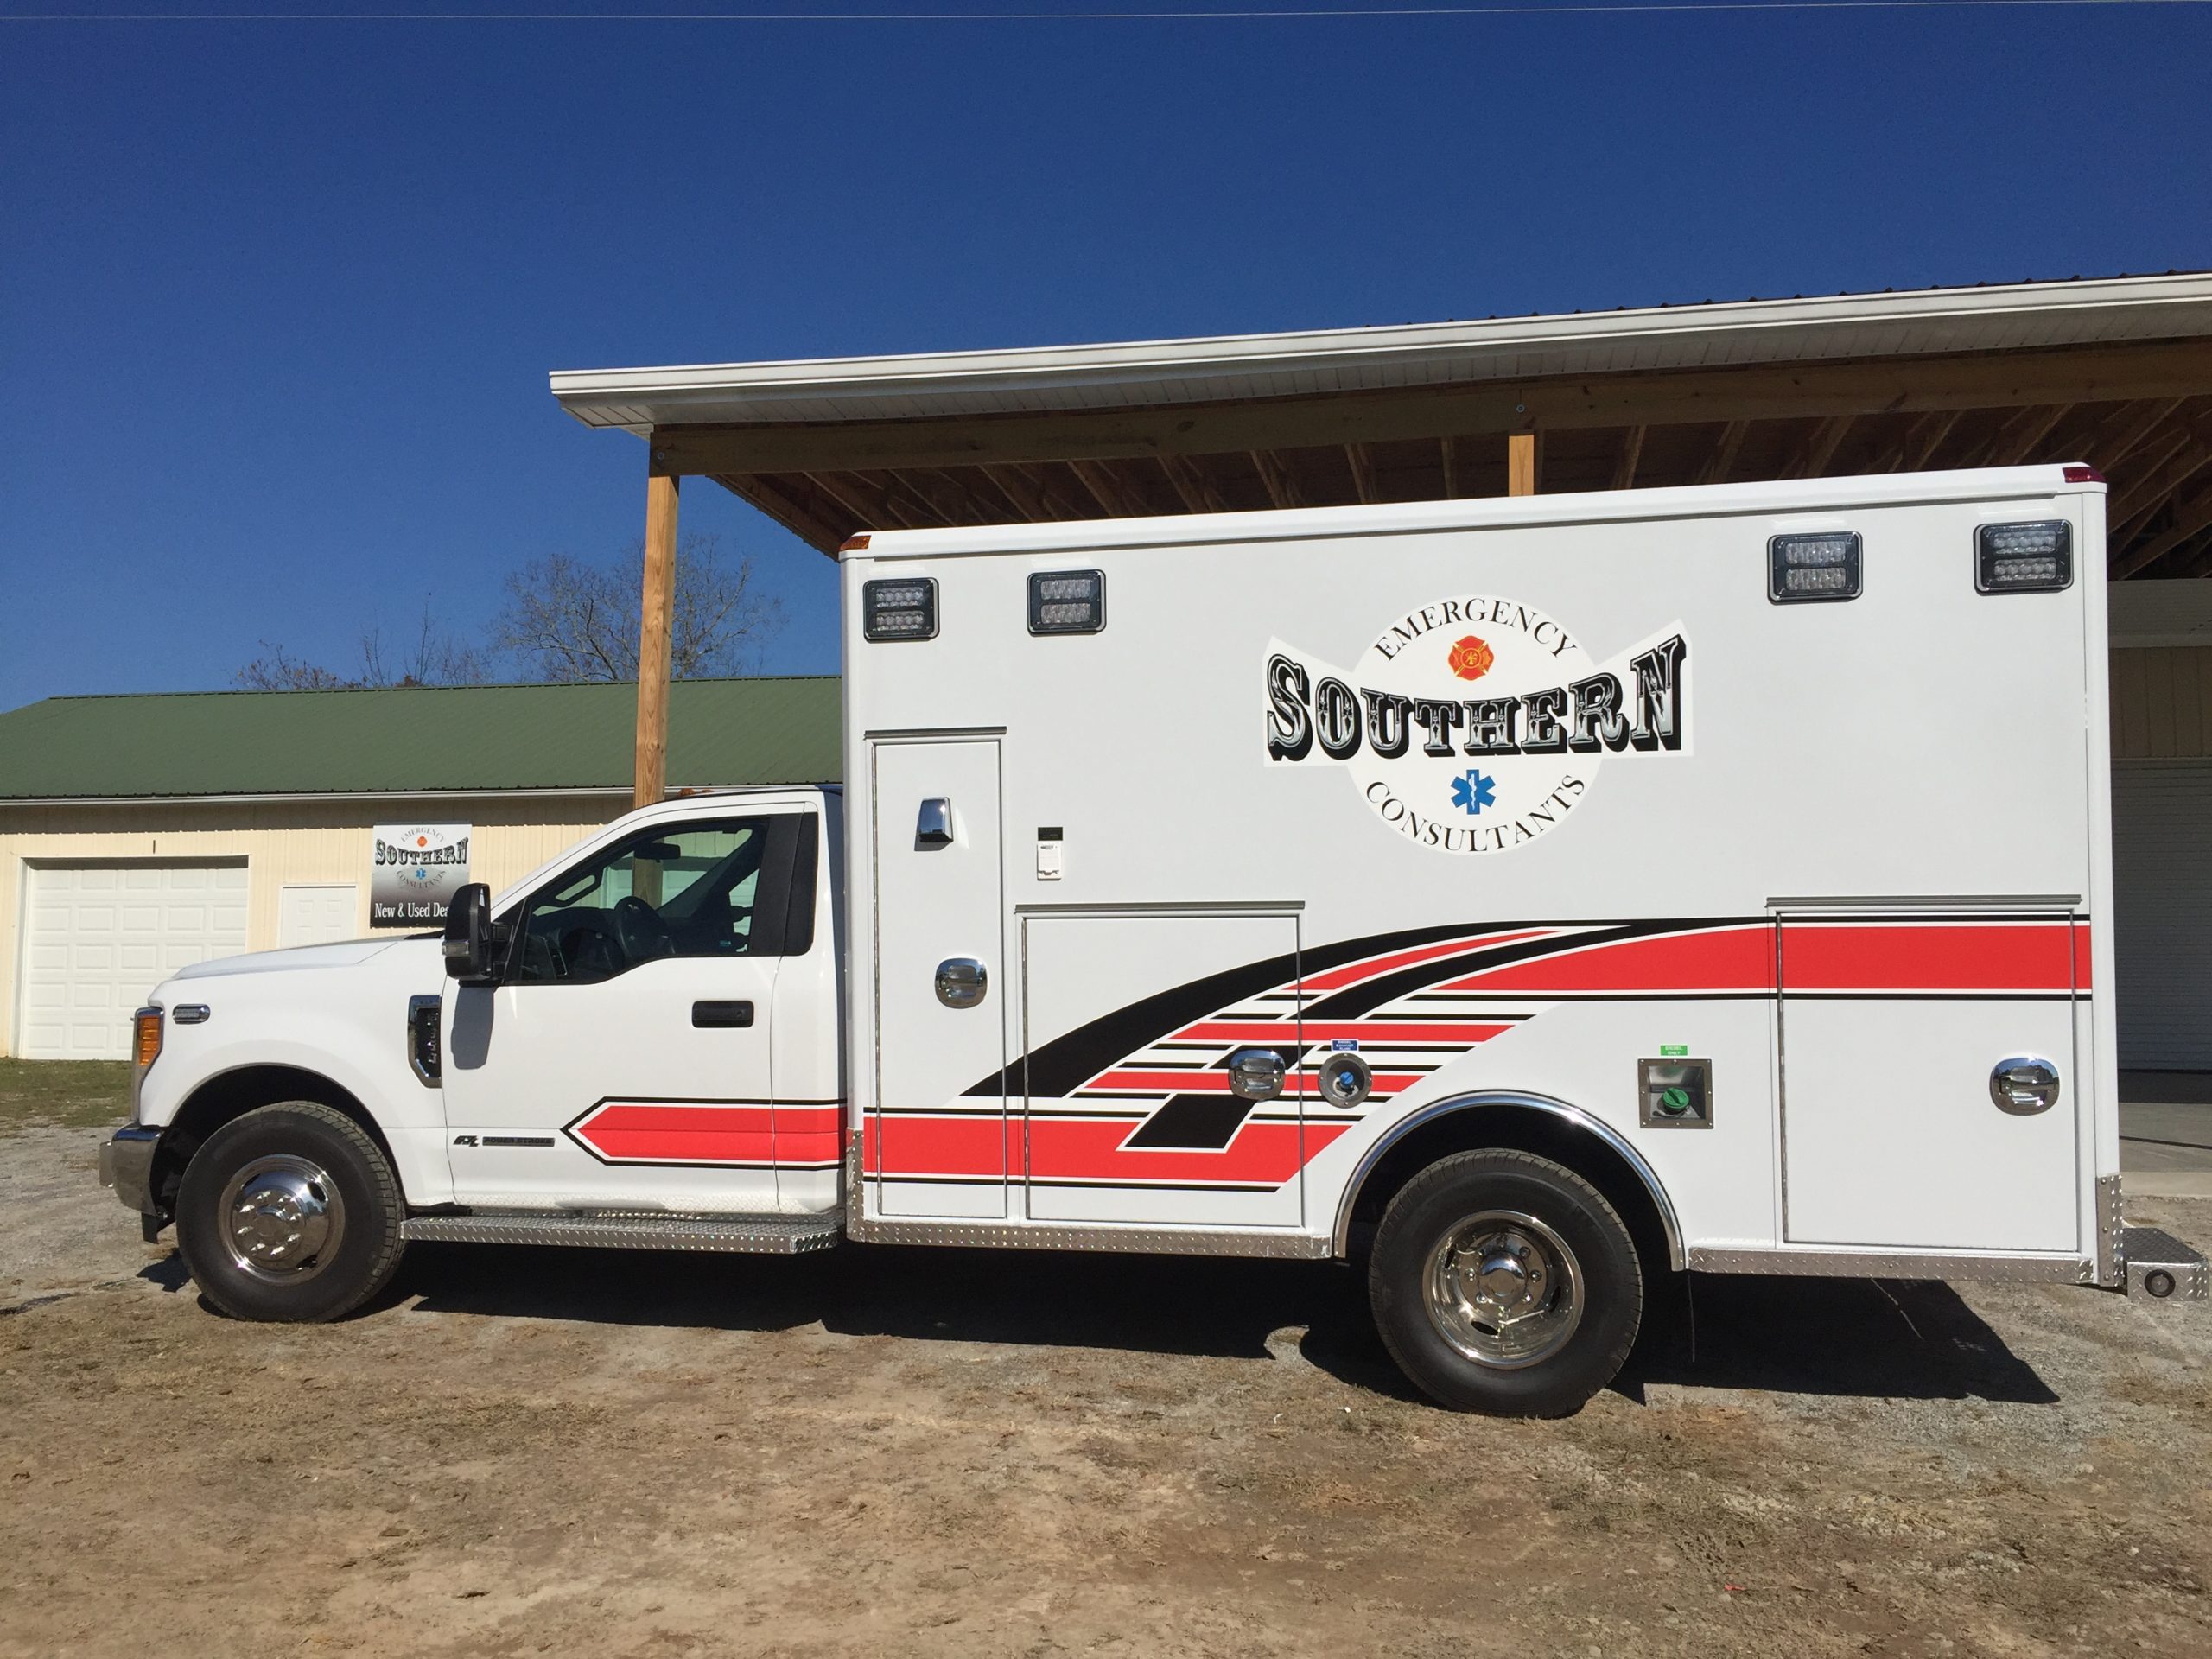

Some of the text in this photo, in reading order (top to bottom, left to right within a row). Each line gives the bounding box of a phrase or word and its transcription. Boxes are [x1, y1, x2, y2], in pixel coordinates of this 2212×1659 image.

[1373, 597, 1578, 661] EMERGENCY
[1267, 633, 1688, 762] SOUTHERN
[1365, 774, 1586, 852] CONSULTANTS
[401, 827, 445, 842] EMERGENCY
[375, 836, 469, 866] SOUTHERN
[396, 870, 446, 889] CONSULTANTS
[375, 903, 395, 918] New
[397, 903, 405, 918] &
[408, 902, 430, 918] Used
